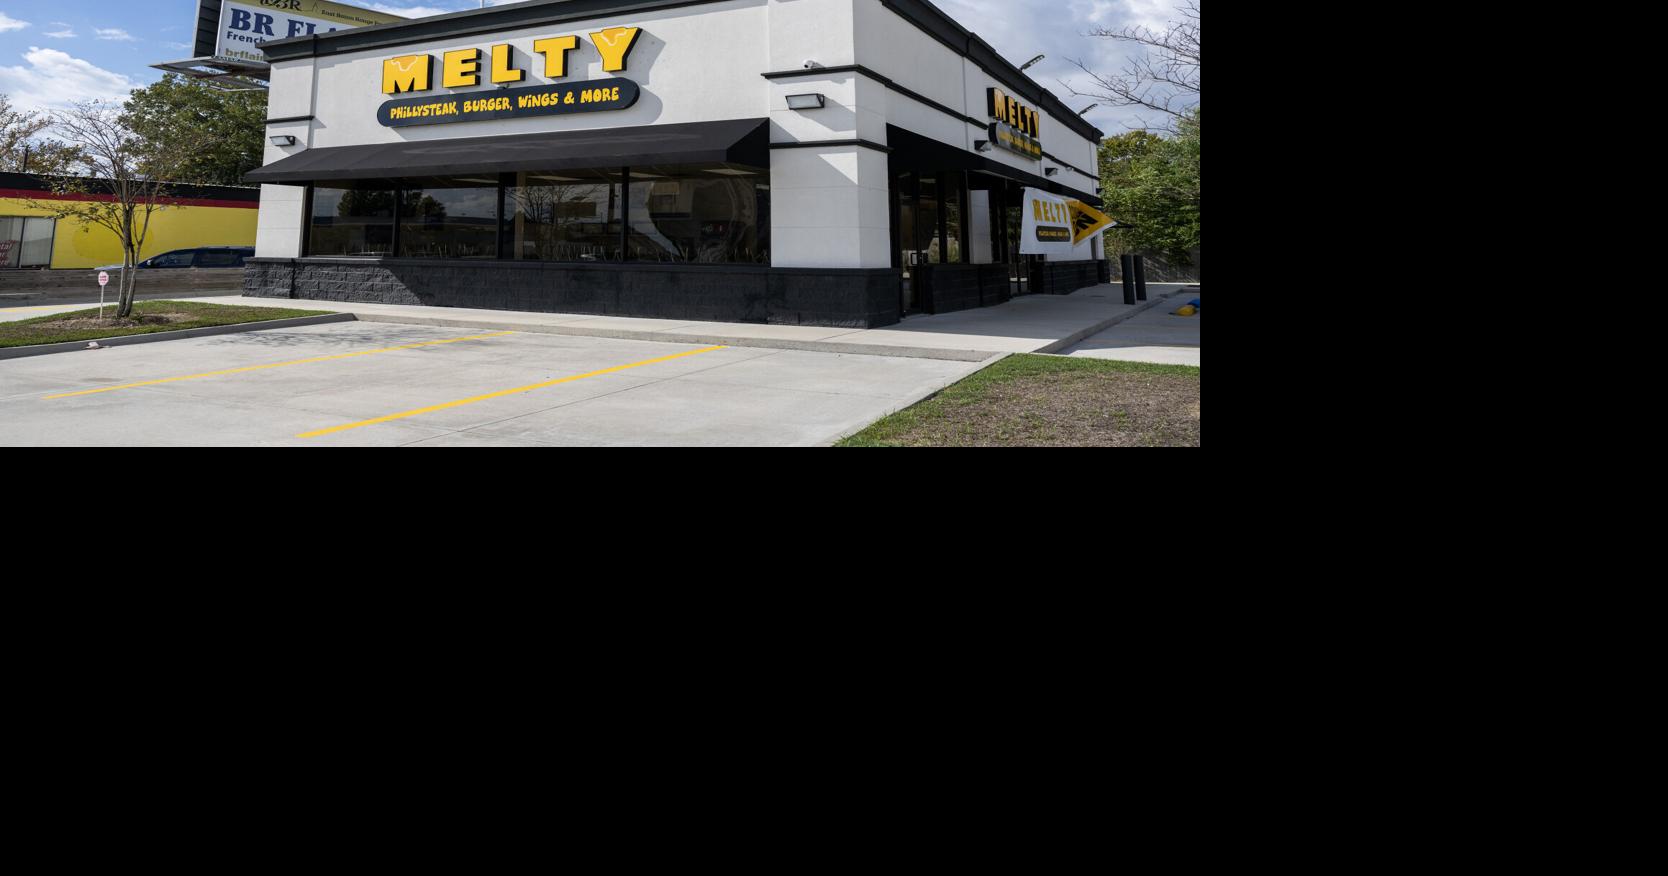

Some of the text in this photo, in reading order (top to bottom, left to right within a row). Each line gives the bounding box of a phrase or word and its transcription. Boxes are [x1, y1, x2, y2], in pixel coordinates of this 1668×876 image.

[229, 8, 337, 38] BR FL
[382, 27, 642, 95] MELTY
[463, 96, 513, 114] BURGER,
[563, 91, 575, 105] &
[580, 86, 620, 103] MORE
[989, 88, 1040, 138] MELTY
